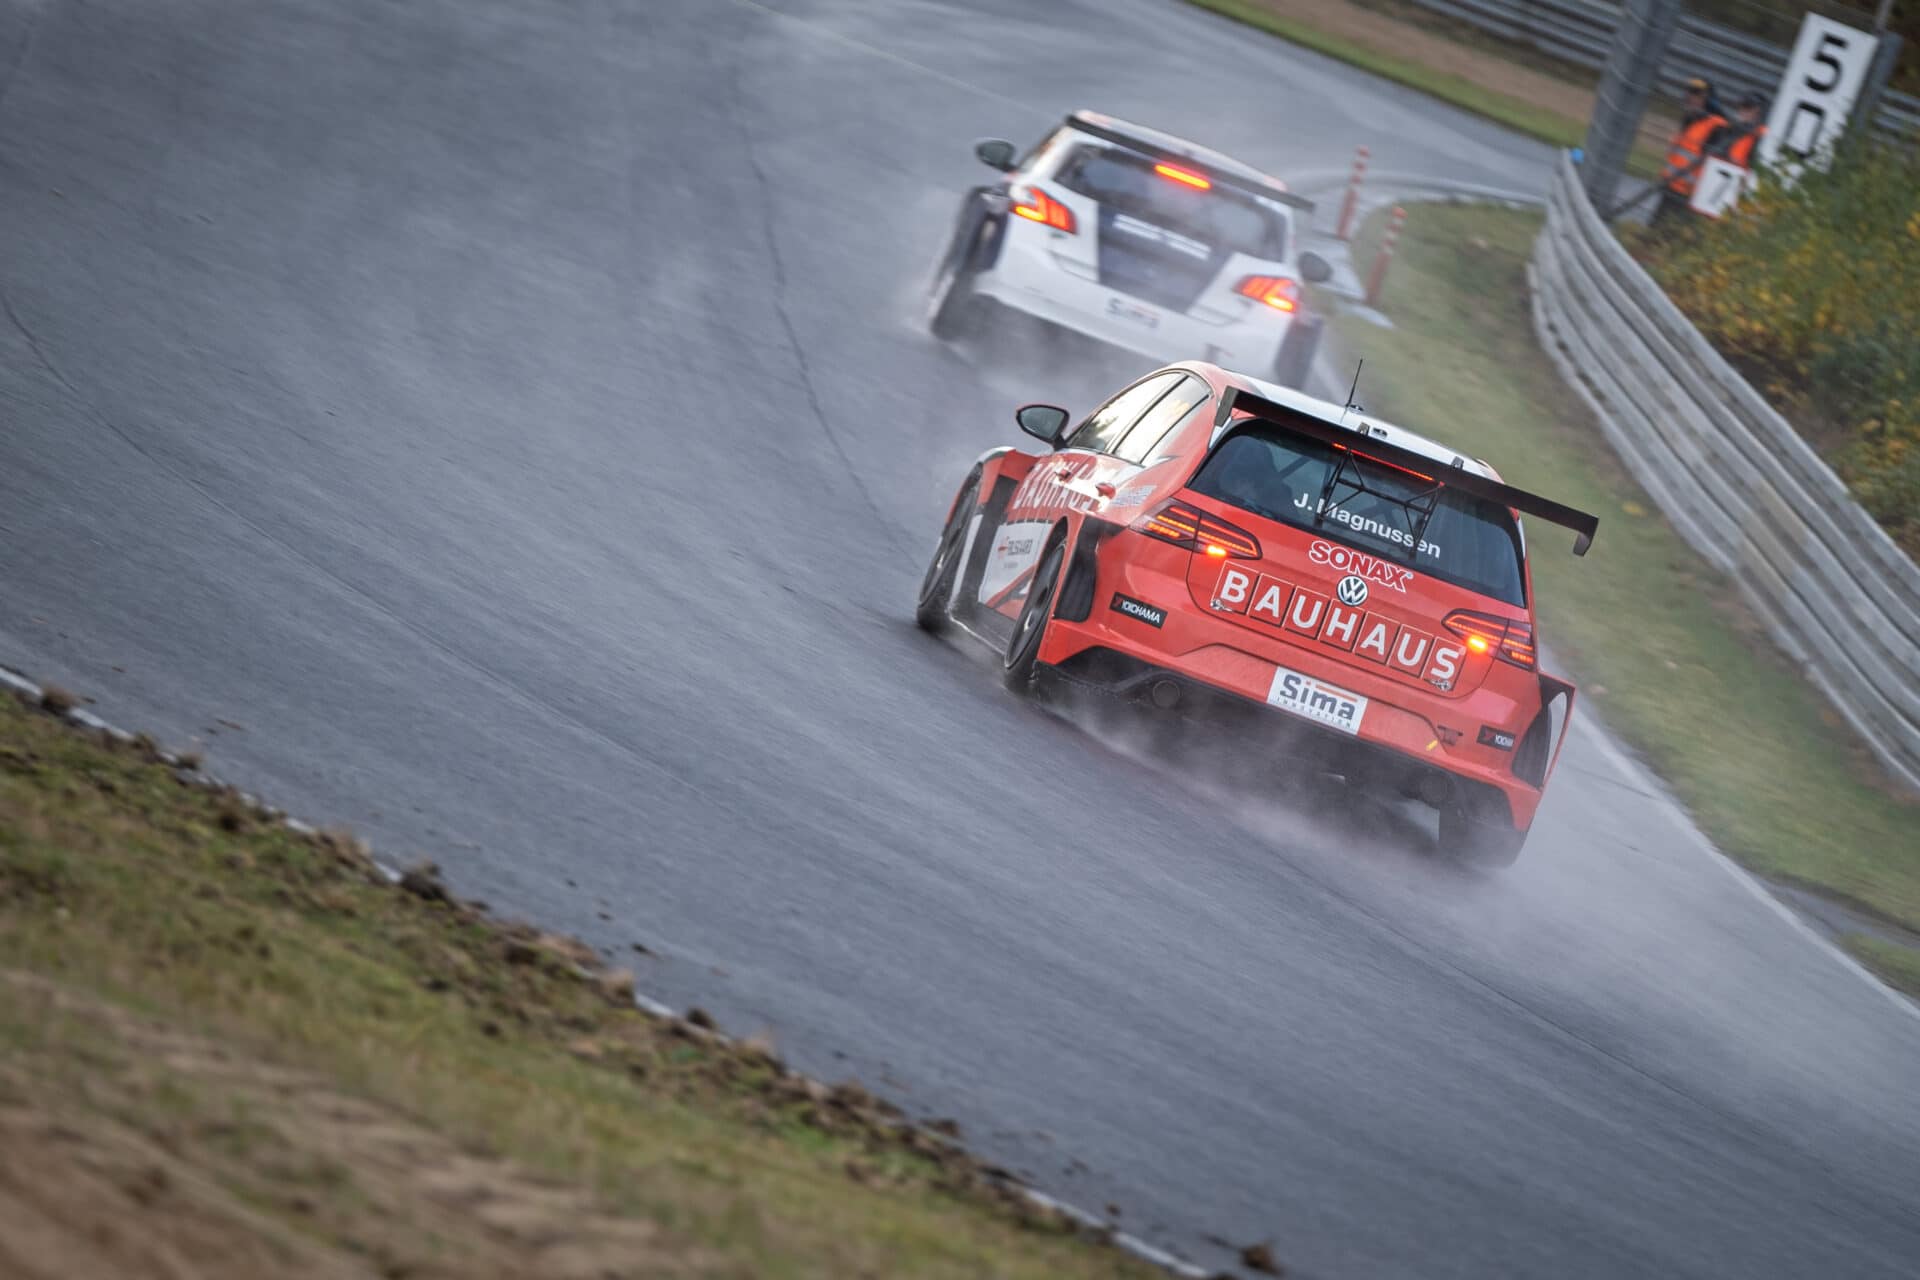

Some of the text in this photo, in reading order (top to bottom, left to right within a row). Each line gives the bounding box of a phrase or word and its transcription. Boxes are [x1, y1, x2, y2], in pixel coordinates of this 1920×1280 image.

[1293, 493, 1441, 558] J. Magnussen
[1308, 540, 1408, 593] SONAX
[1219, 569, 1460, 680] BAUHAUS
[1279, 674, 1355, 721] Sima
